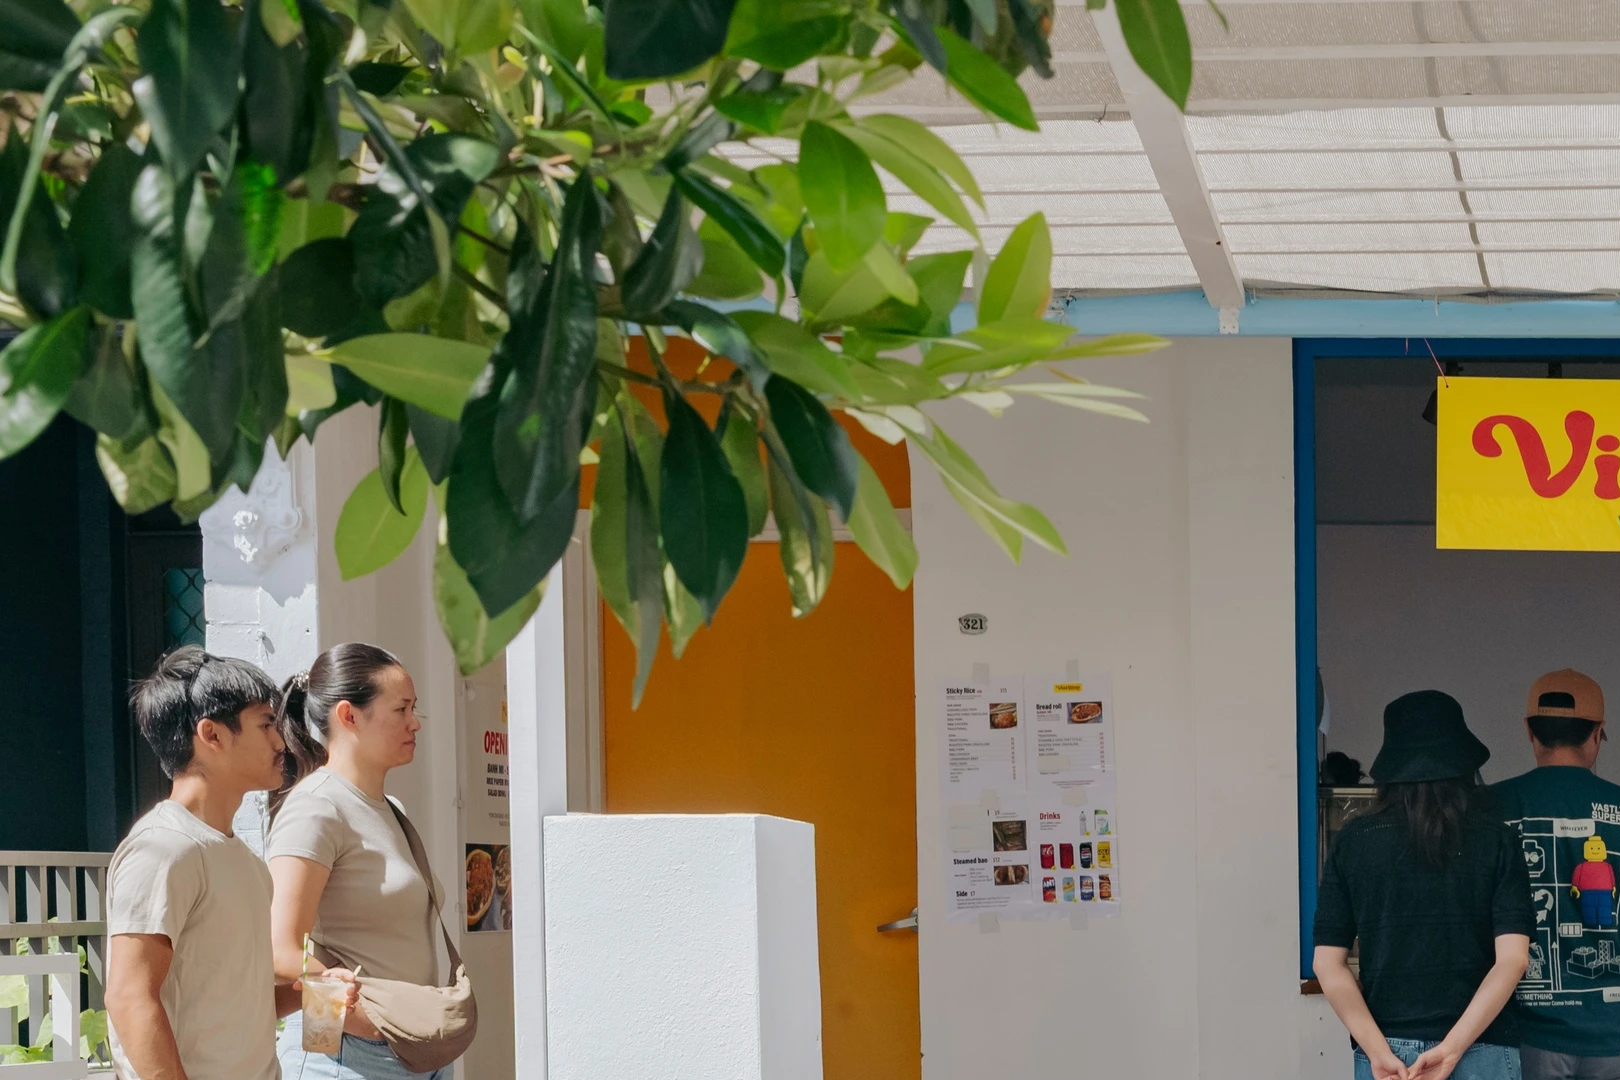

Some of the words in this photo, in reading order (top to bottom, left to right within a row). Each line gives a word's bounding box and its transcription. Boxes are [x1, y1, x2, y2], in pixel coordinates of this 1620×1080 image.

[962, 618, 984, 630] 321
[1040, 812, 1061, 820] Drinks
[953, 857, 977, 865] Steamed
[1516, 993, 1553, 1001] SOMETHING
